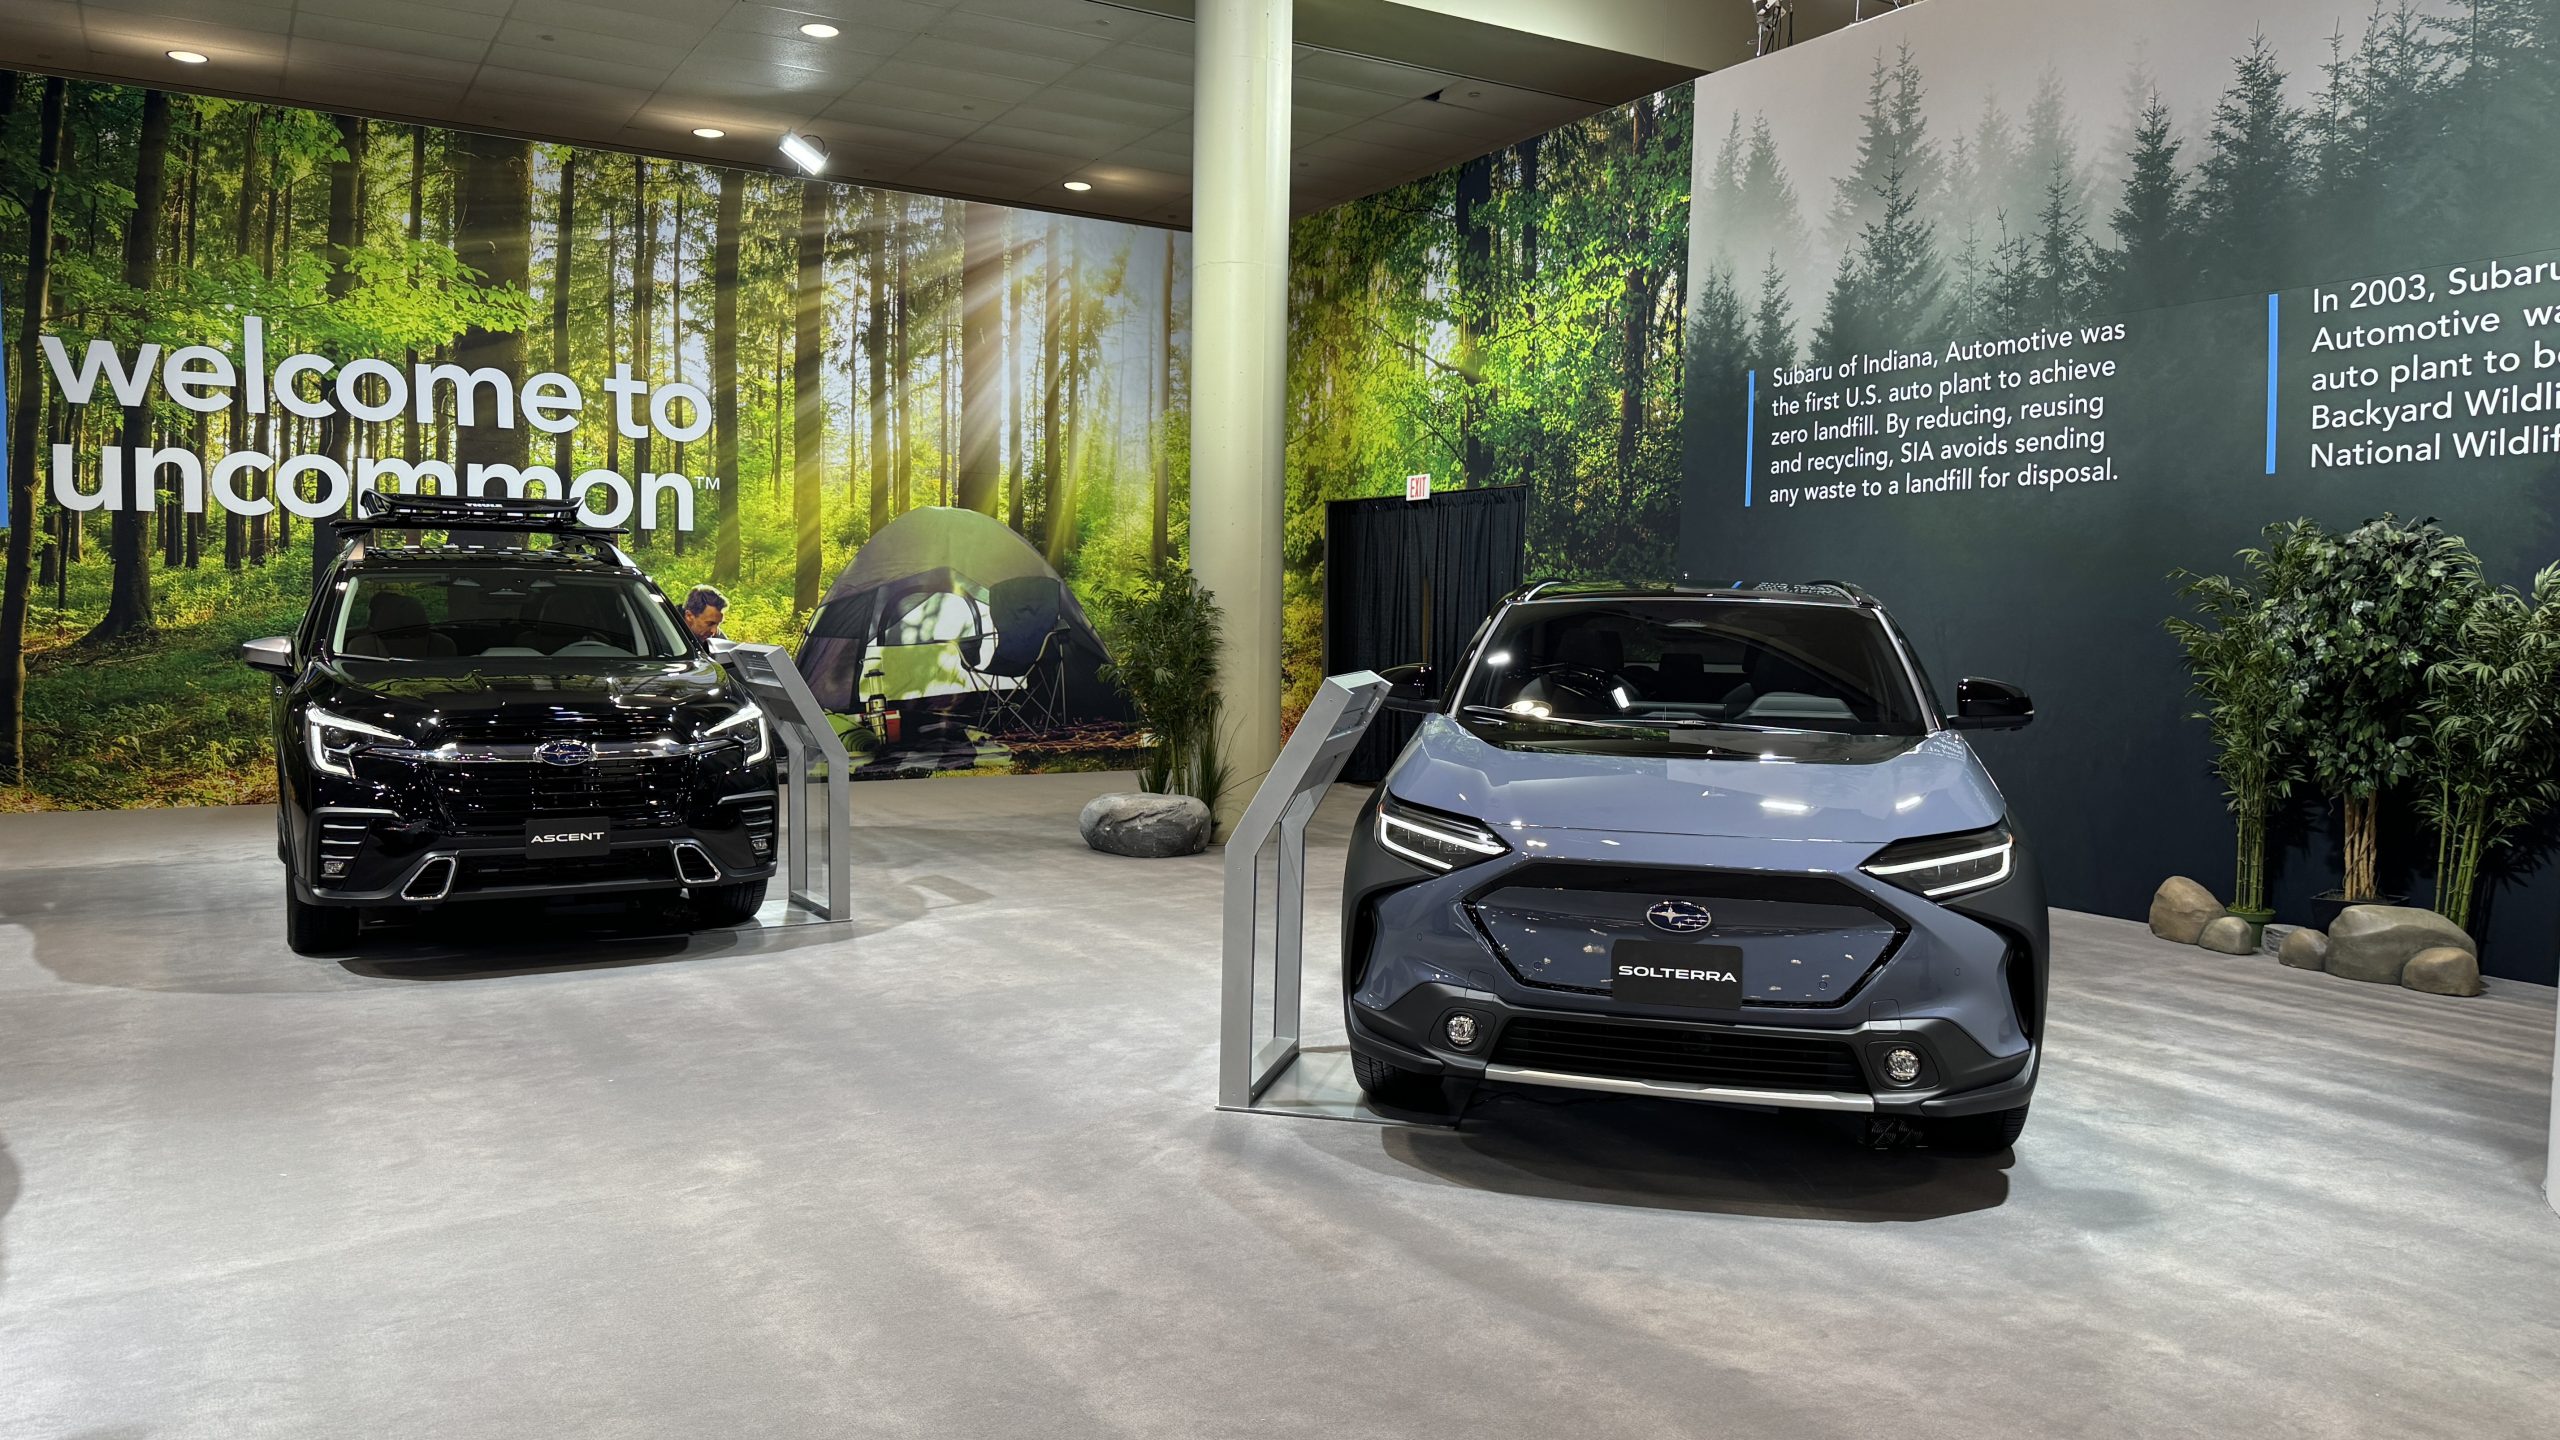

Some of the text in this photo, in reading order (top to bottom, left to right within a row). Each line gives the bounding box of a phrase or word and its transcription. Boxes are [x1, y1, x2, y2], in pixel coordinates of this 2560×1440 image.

[2313, 288, 2338, 314] In
[2349, 273, 2436, 309] 2003,
[2311, 309, 2501, 353] Automotive
[39, 315, 713, 443] welcome to
[1772, 323, 2126, 388] Subaru of Indiana, Automotive was
[2311, 339, 2560, 393] auto plant to b
[1771, 358, 2116, 416] the first U.S. auto plant to achieve
[1771, 392, 2104, 446] zero landfill. By reducing, reusing
[2312, 390, 2453, 432] Backyard
[1771, 425, 2105, 475] and recycling, SIA avoids sending
[2311, 432, 2441, 468] National
[1409, 476, 1427, 498] EXIT
[1769, 456, 2118, 508] any waste to a landfill for disposal.
[530, 831, 605, 844] ASCENT
[1618, 965, 1737, 983] SOLTERRA
